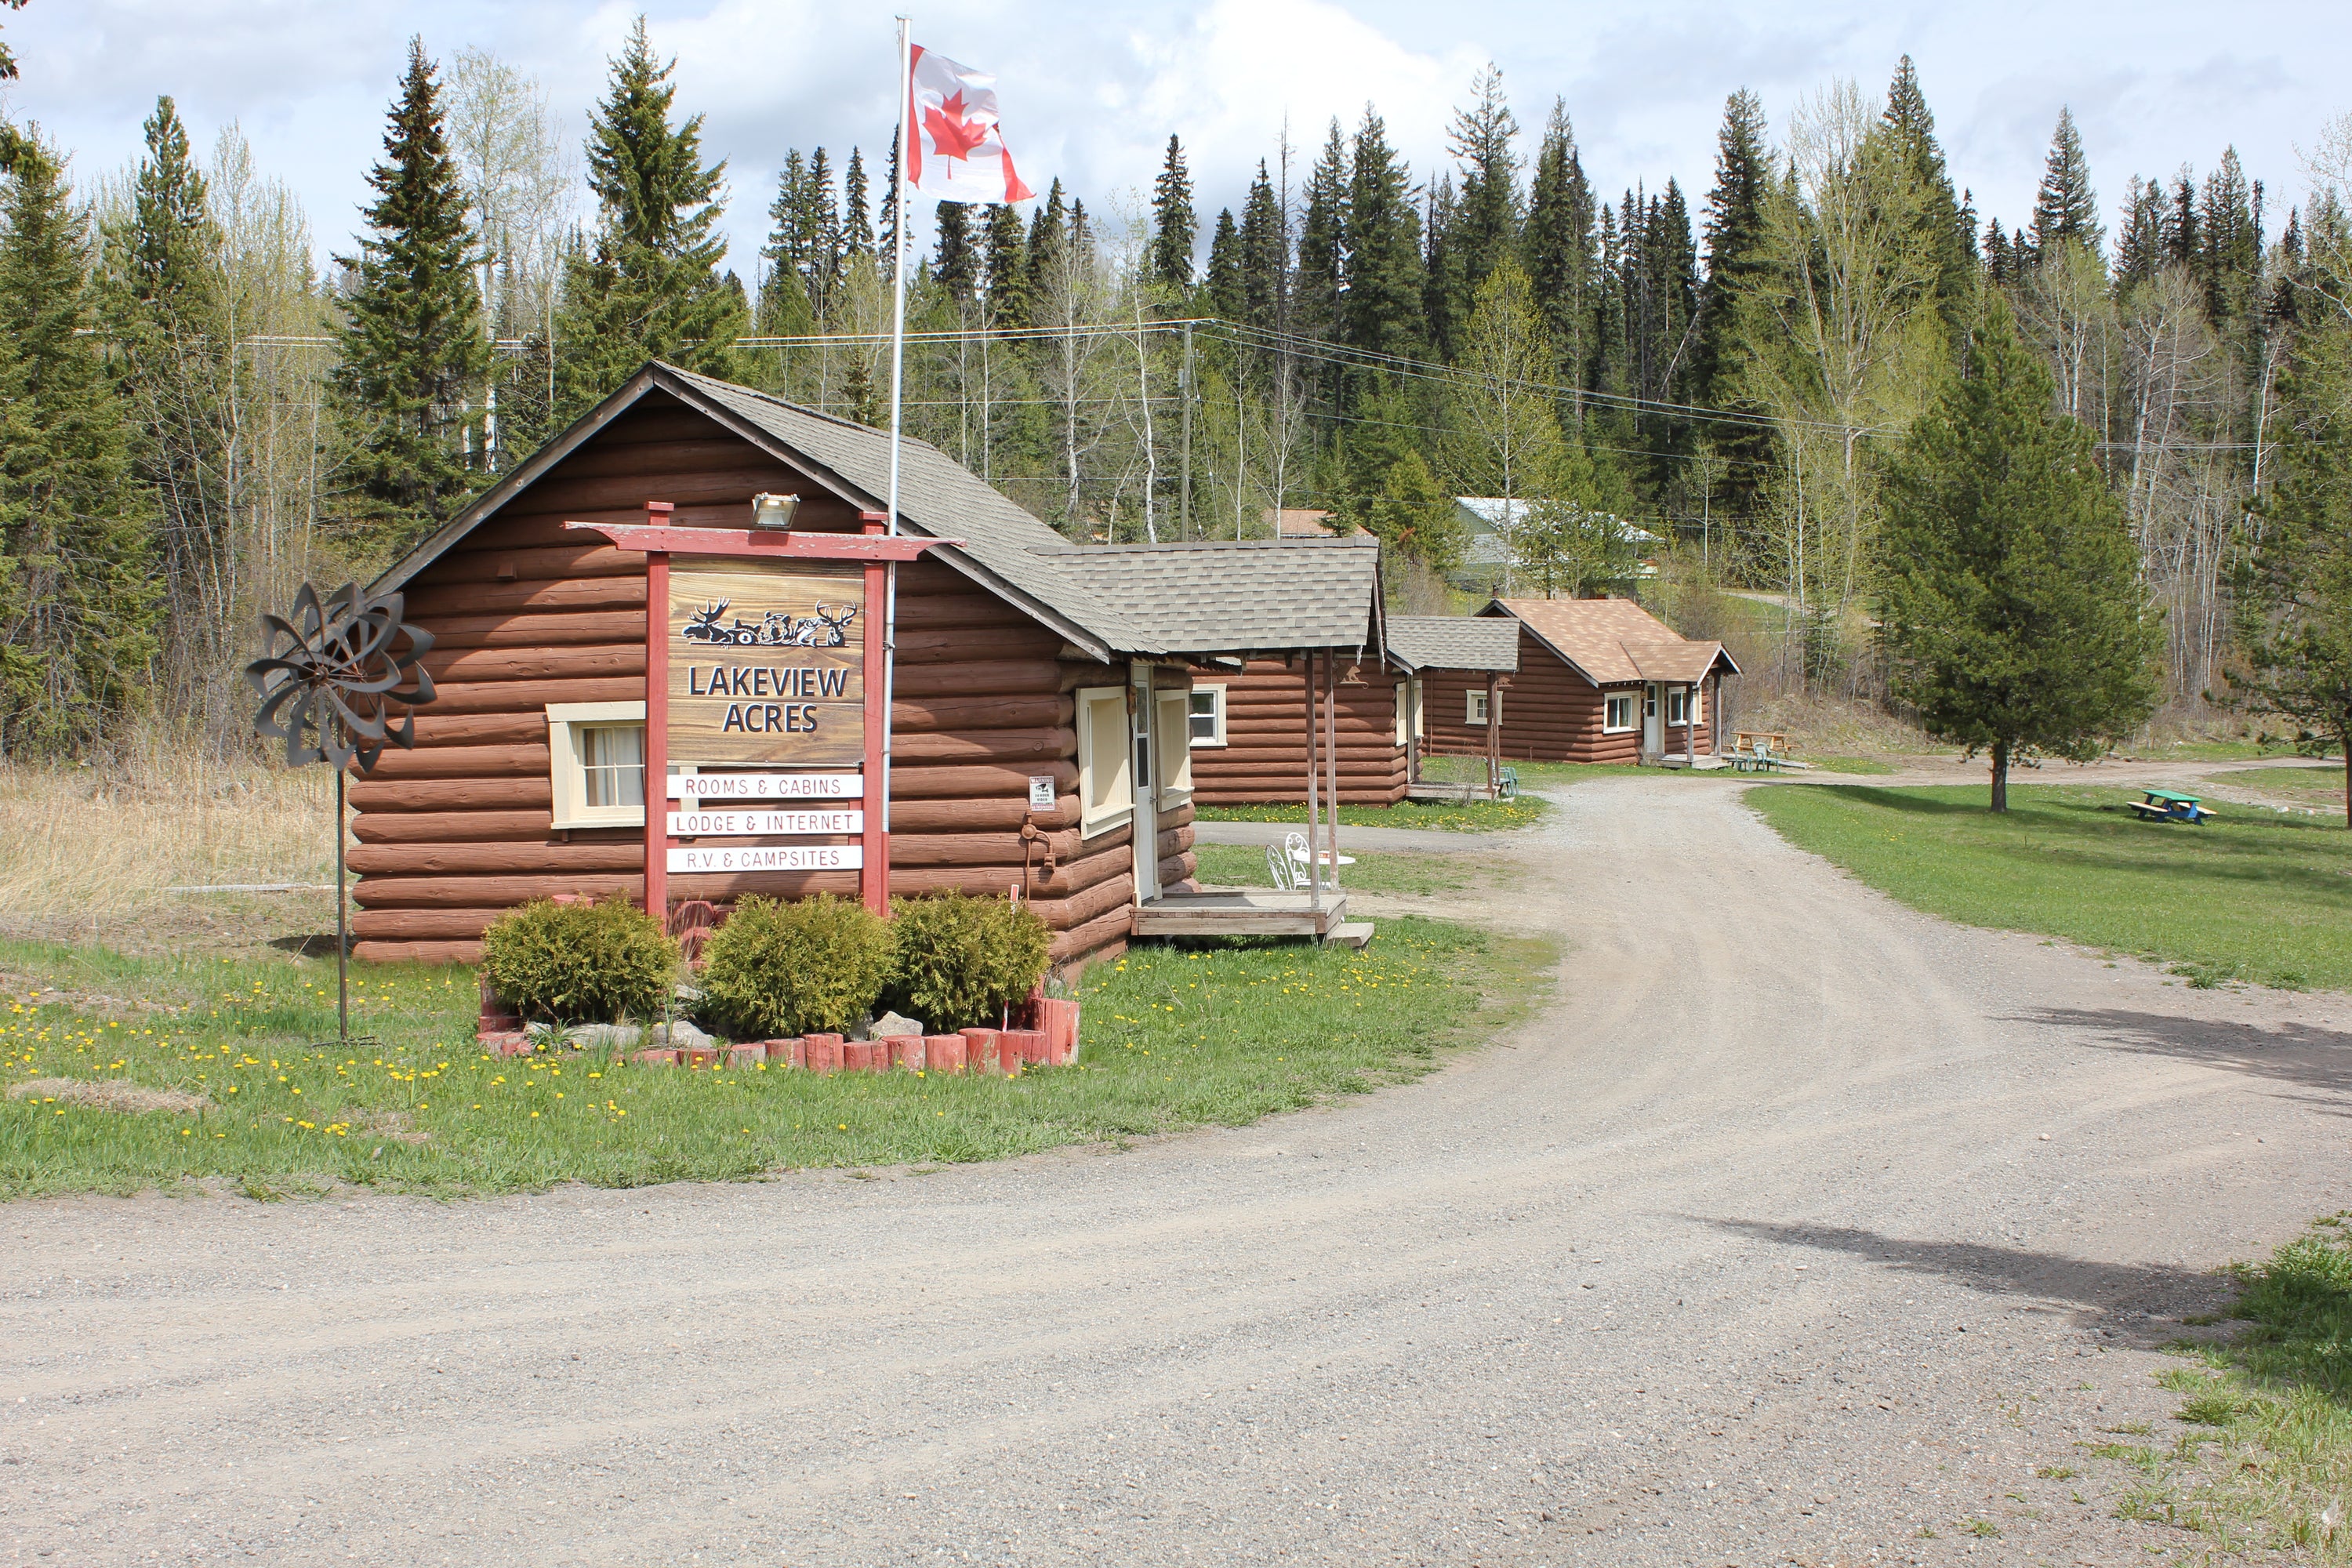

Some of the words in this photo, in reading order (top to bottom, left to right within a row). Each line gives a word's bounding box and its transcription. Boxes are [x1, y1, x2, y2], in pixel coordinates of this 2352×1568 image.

[688, 666, 848, 697] LAKEVIEW
[721, 702, 818, 733] ACRES
[685, 779, 749, 794] ROOMS
[757, 779, 768, 794] &
[779, 779, 841, 794] CABINS
[677, 815, 735, 831] LODGE
[746, 815, 756, 831] &
[767, 815, 853, 830] INTERNET
[687, 852, 717, 868] R.V.
[723, 852, 733, 867] &
[741, 850, 840, 867] CAMPSITES
